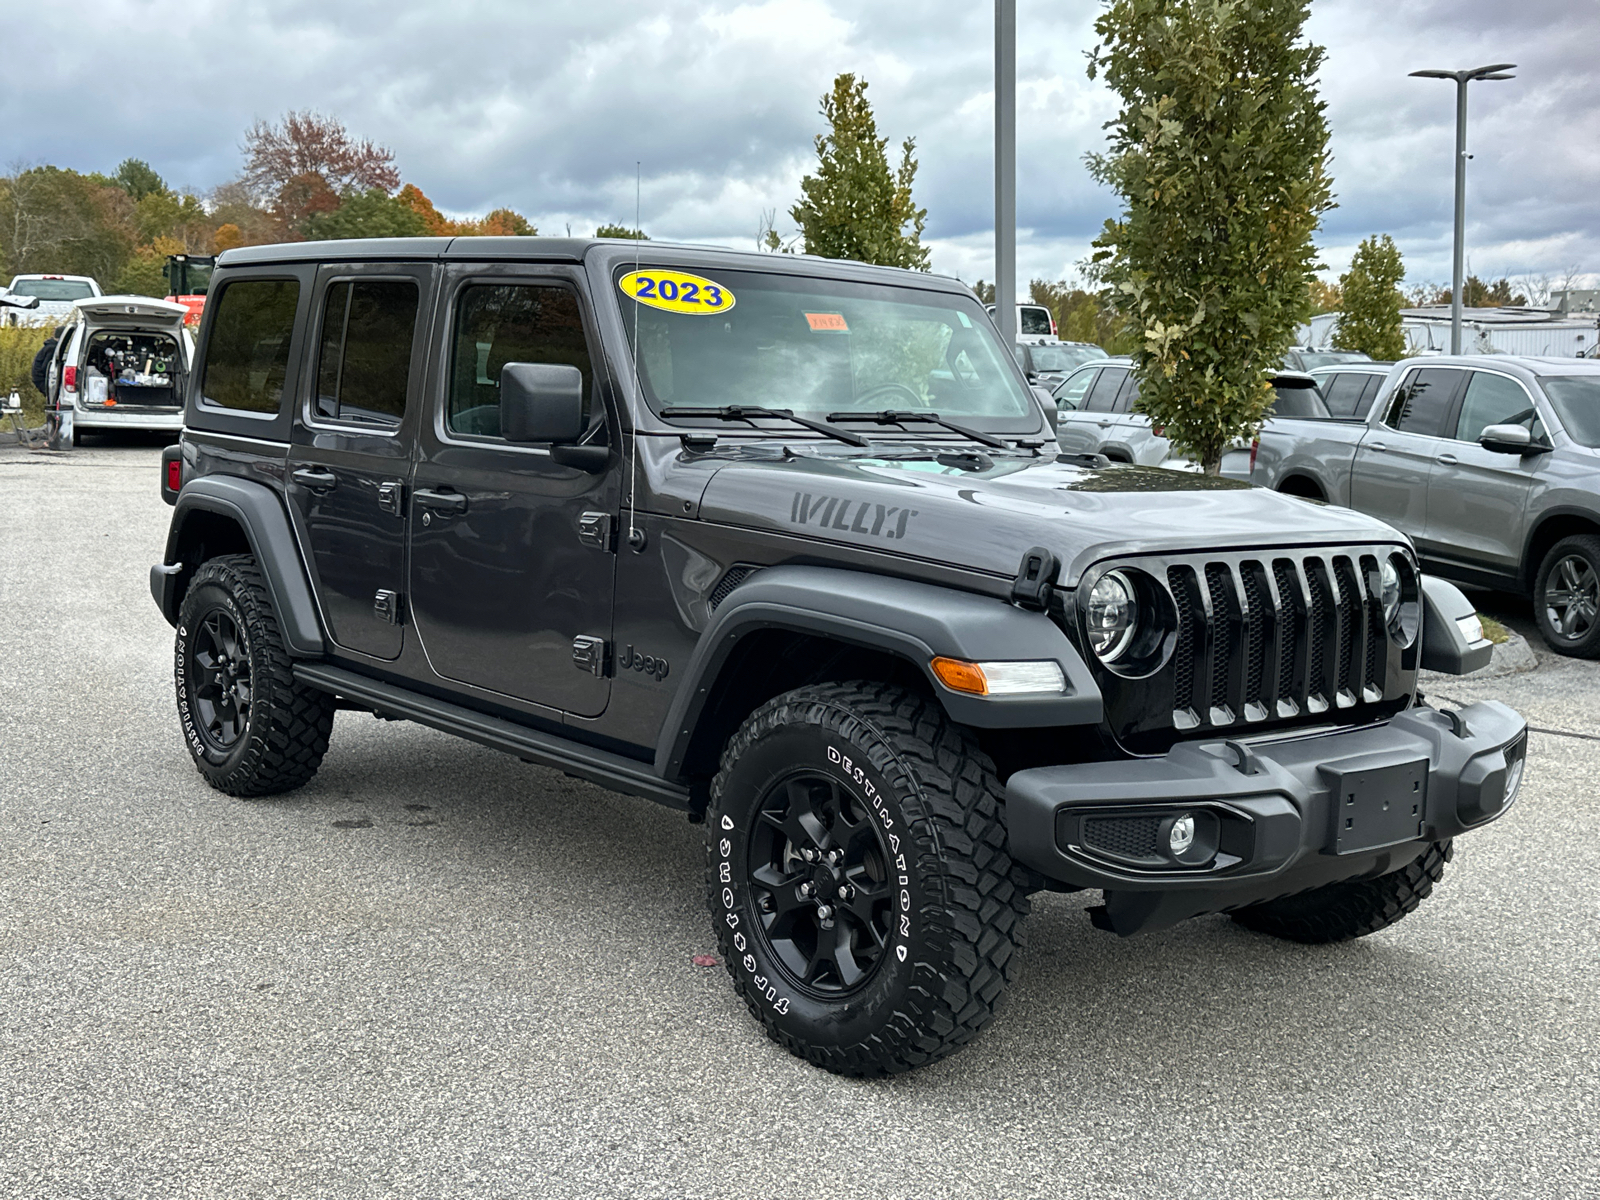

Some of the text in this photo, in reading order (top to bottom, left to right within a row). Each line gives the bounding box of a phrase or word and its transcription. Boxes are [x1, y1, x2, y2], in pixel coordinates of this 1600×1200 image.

[636, 277, 724, 307] 2023
[791, 492, 919, 539] WILLYS
[619, 644, 669, 682] Jeep
[178, 639, 205, 756] DESTINATION
[827, 745, 911, 938] DESTINATION
